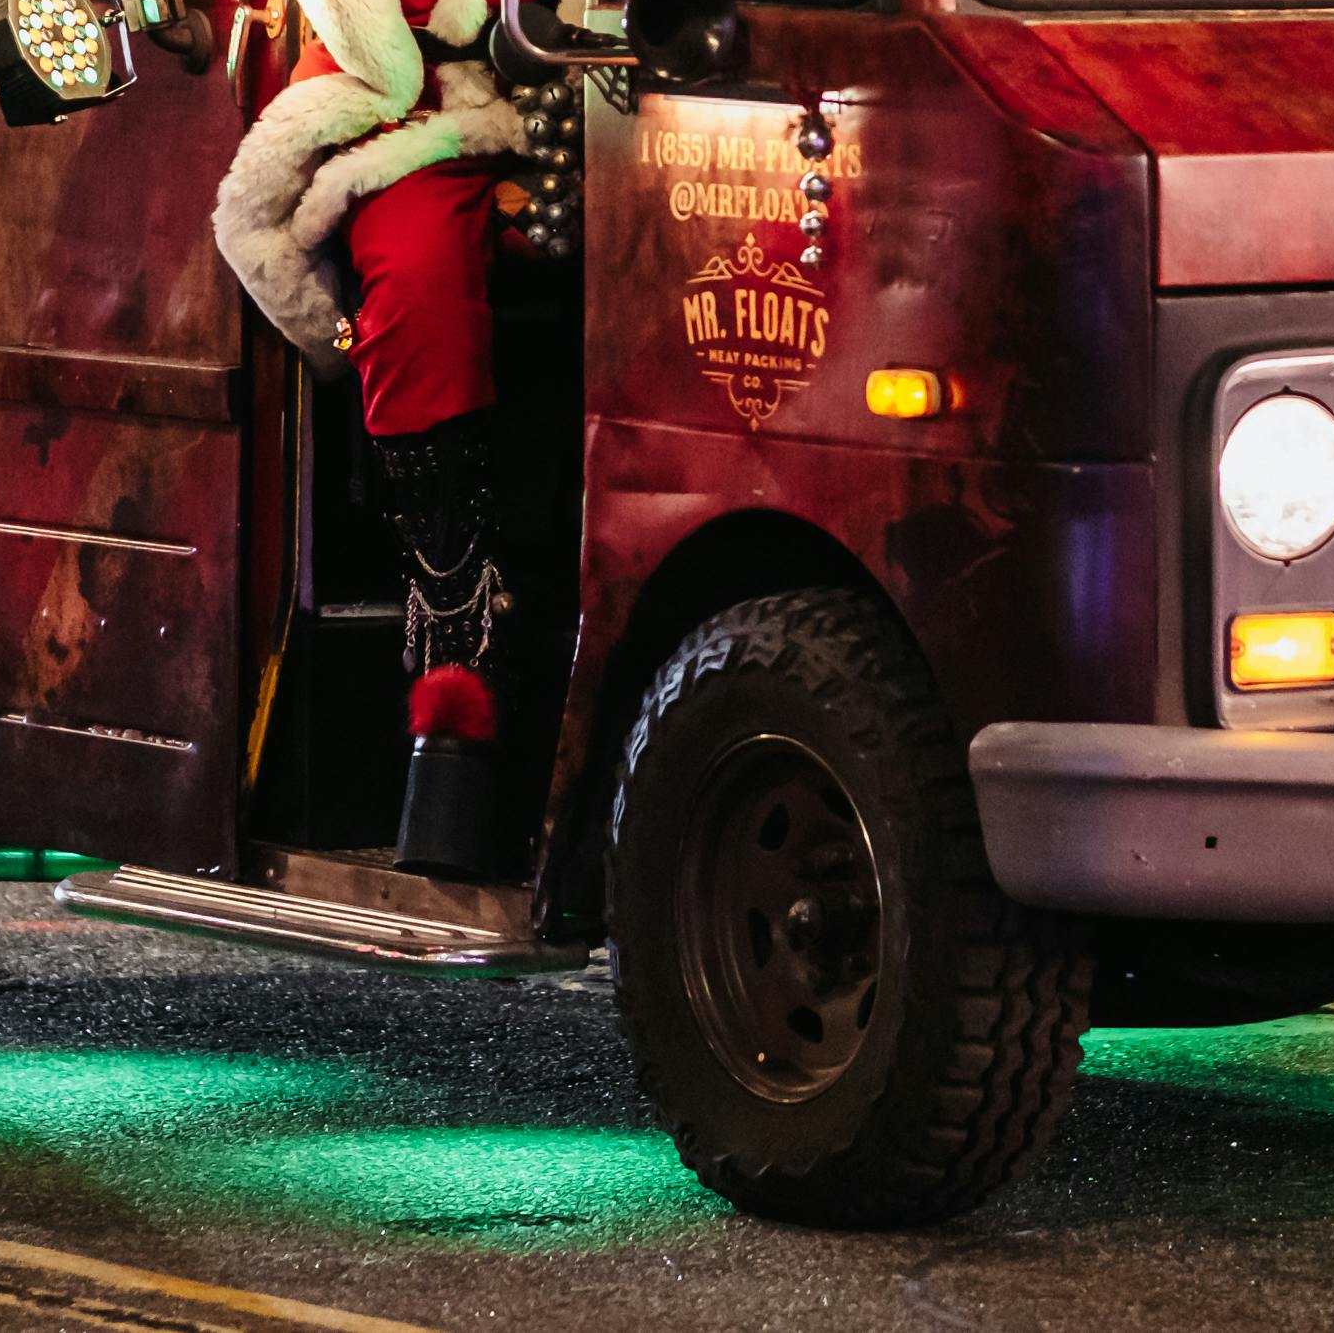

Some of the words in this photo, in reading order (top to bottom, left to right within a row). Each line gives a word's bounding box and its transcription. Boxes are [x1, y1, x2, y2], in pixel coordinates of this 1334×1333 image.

[641, 130, 651, 163] 1
[655, 130, 712, 173] (855)
[683, 290, 727, 345] MR.
[735, 288, 830, 358] FLOATS
[709, 349, 740, 365] MEAT
[744, 352, 802, 372] PACKING
